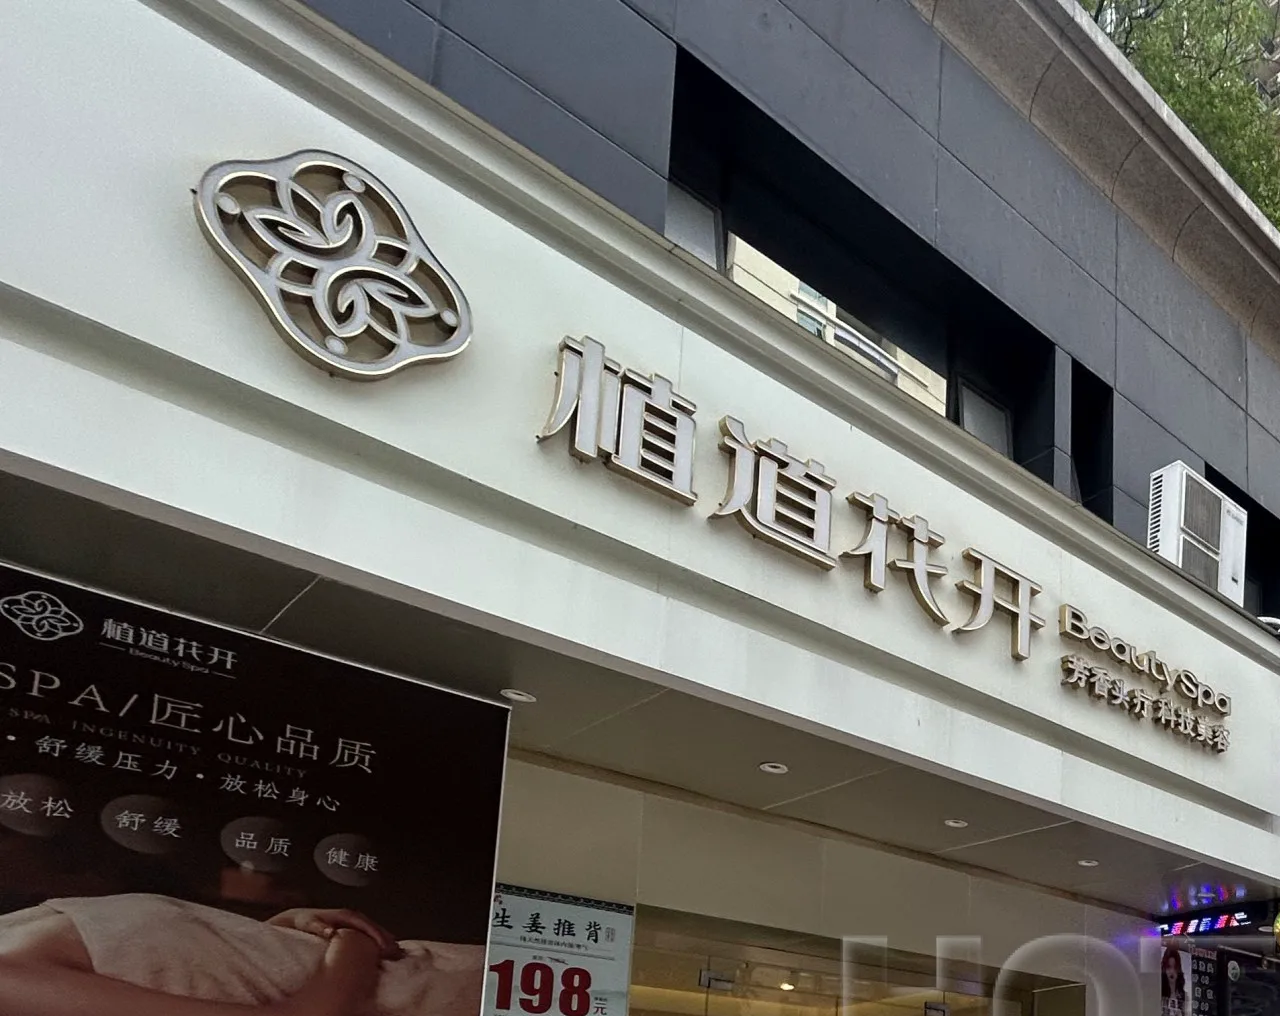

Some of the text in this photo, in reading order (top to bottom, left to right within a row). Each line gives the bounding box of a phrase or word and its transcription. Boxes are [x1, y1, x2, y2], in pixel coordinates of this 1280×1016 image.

[101, 618, 238, 670] 植道花开
[1058, 604, 1232, 717] BeautySpa
[35, 735, 341, 812] 舒缓压力 放松身心
[72, 719, 201, 756] INGENUITY
[217, 752, 309, 779] QUALITY
[1, 790, 380, 872] 放松 舒缓 品质 健康
[492, 908, 602, 943] 生姜推背
[593, 1003, 608, 1016] 元
